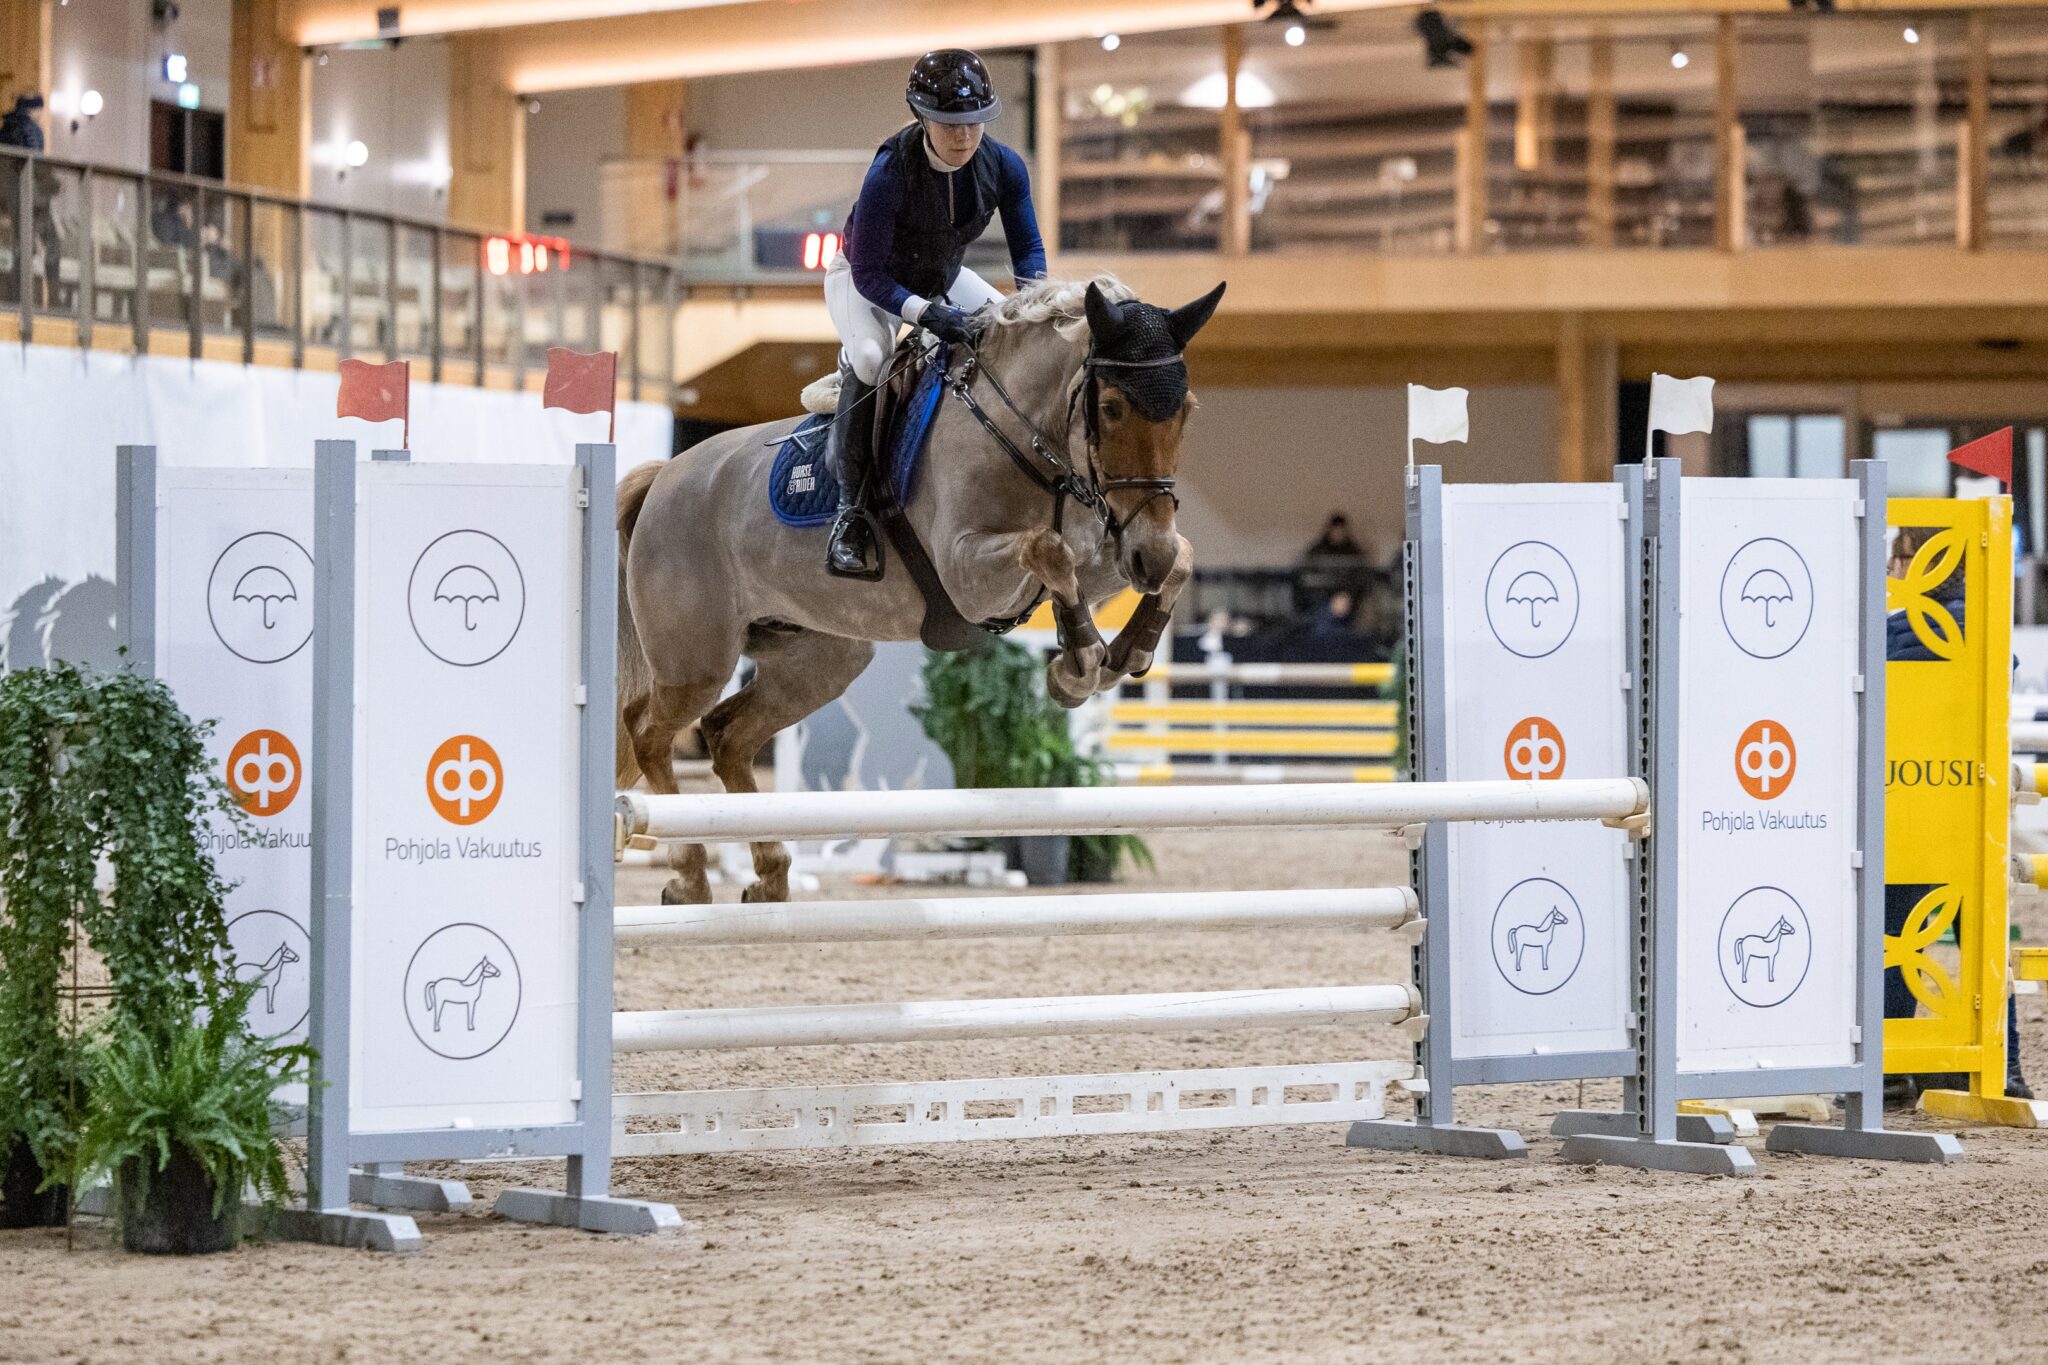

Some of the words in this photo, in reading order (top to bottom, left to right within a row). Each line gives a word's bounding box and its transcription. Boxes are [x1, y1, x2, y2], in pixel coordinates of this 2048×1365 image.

[791, 464, 812, 479] HORSE
[1884, 760, 1975, 787] JOUSI
[1702, 810, 1755, 835] Pohjola
[1758, 809, 1828, 830] Vakuutus
[197, 828, 250, 854] ohjola
[256, 827, 311, 849] Vakuu
[385, 837, 451, 865] Pohjola
[456, 836, 543, 859] Vakuutus
